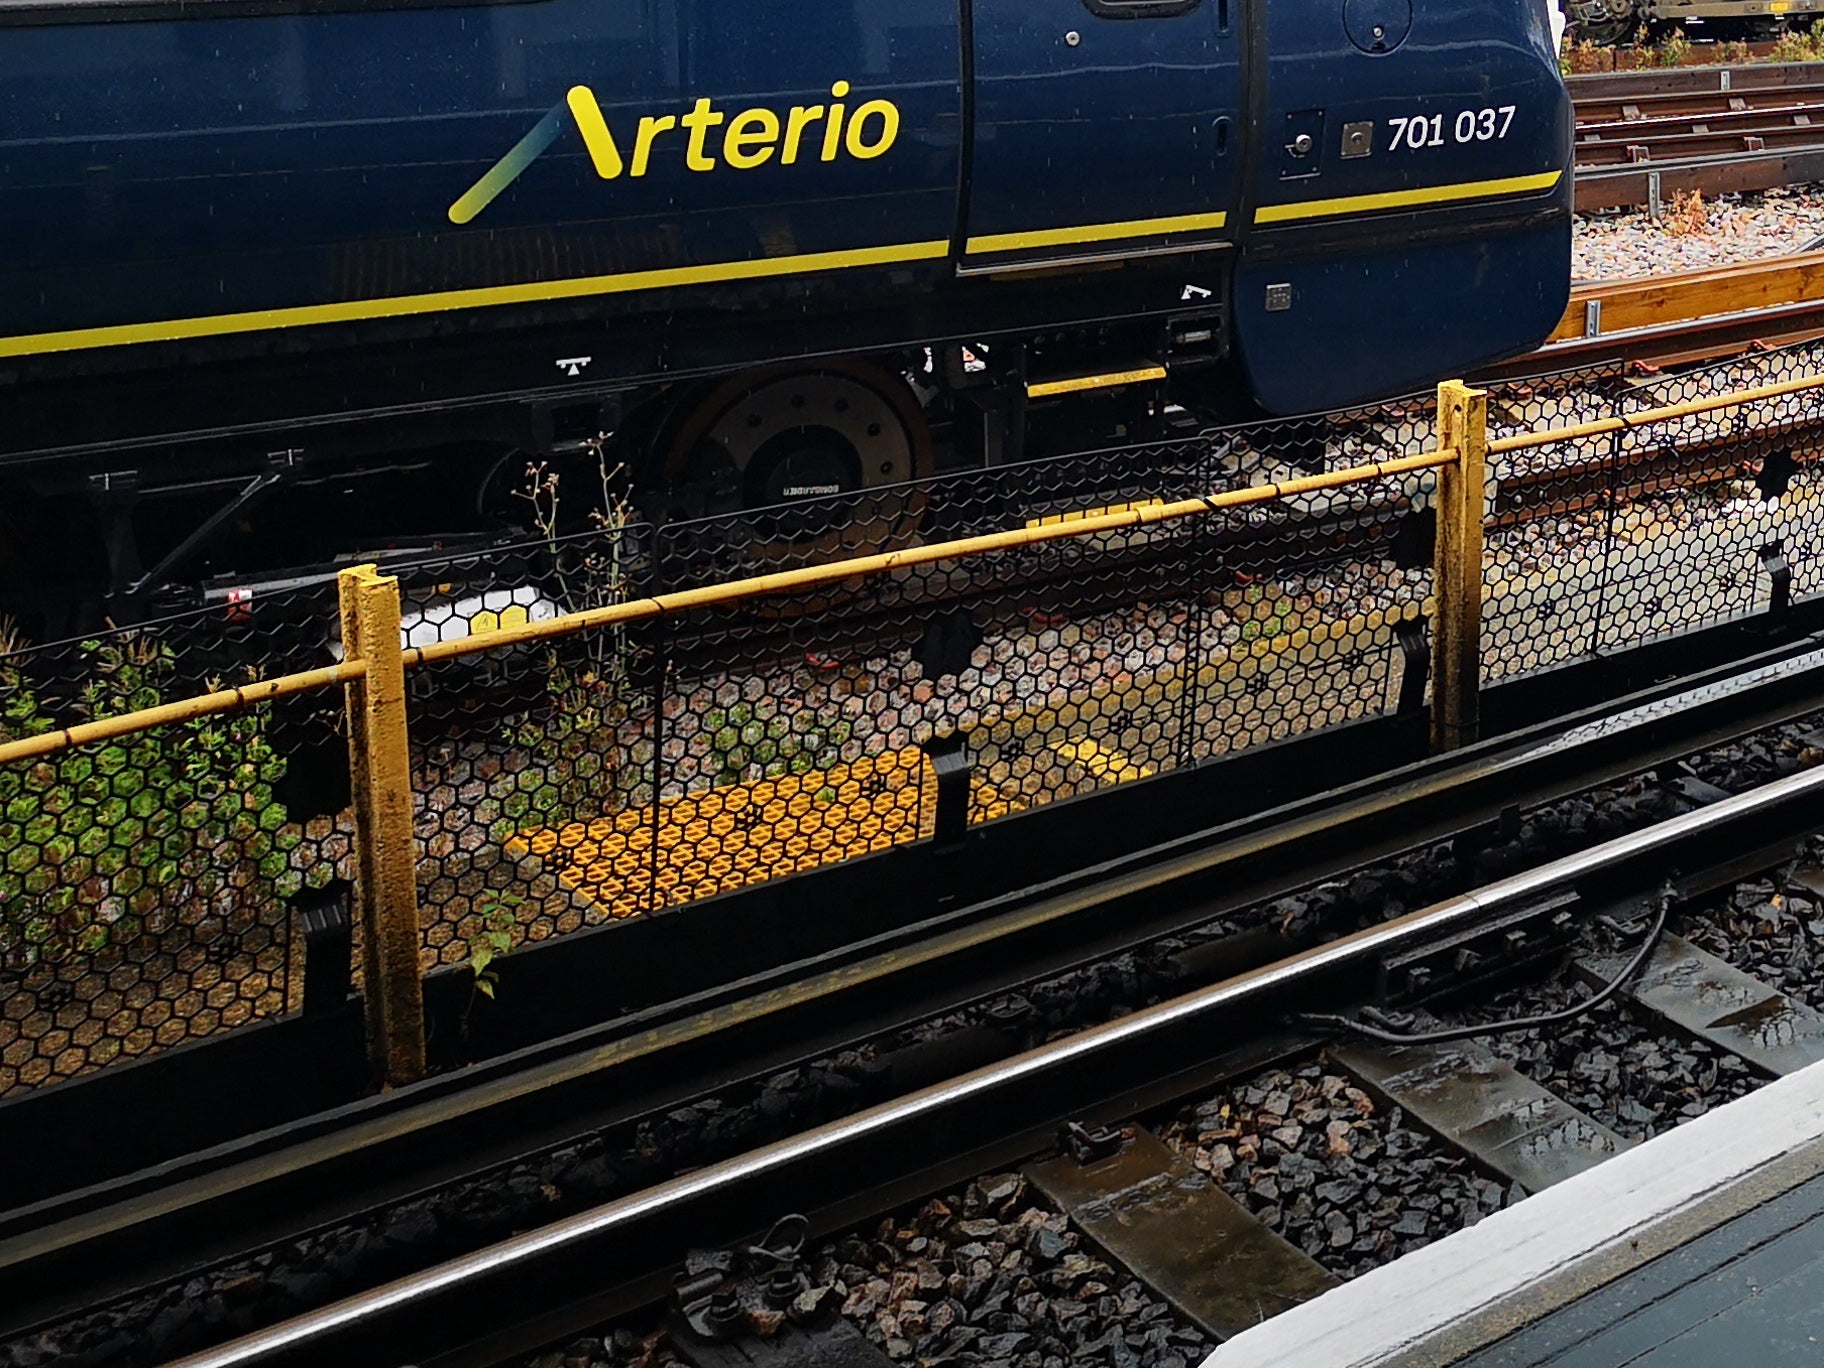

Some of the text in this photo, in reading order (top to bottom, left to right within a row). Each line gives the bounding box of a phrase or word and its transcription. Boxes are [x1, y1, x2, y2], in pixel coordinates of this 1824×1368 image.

[448, 80, 900, 224] Arterio
[1388, 105, 1517, 151] 701 037
